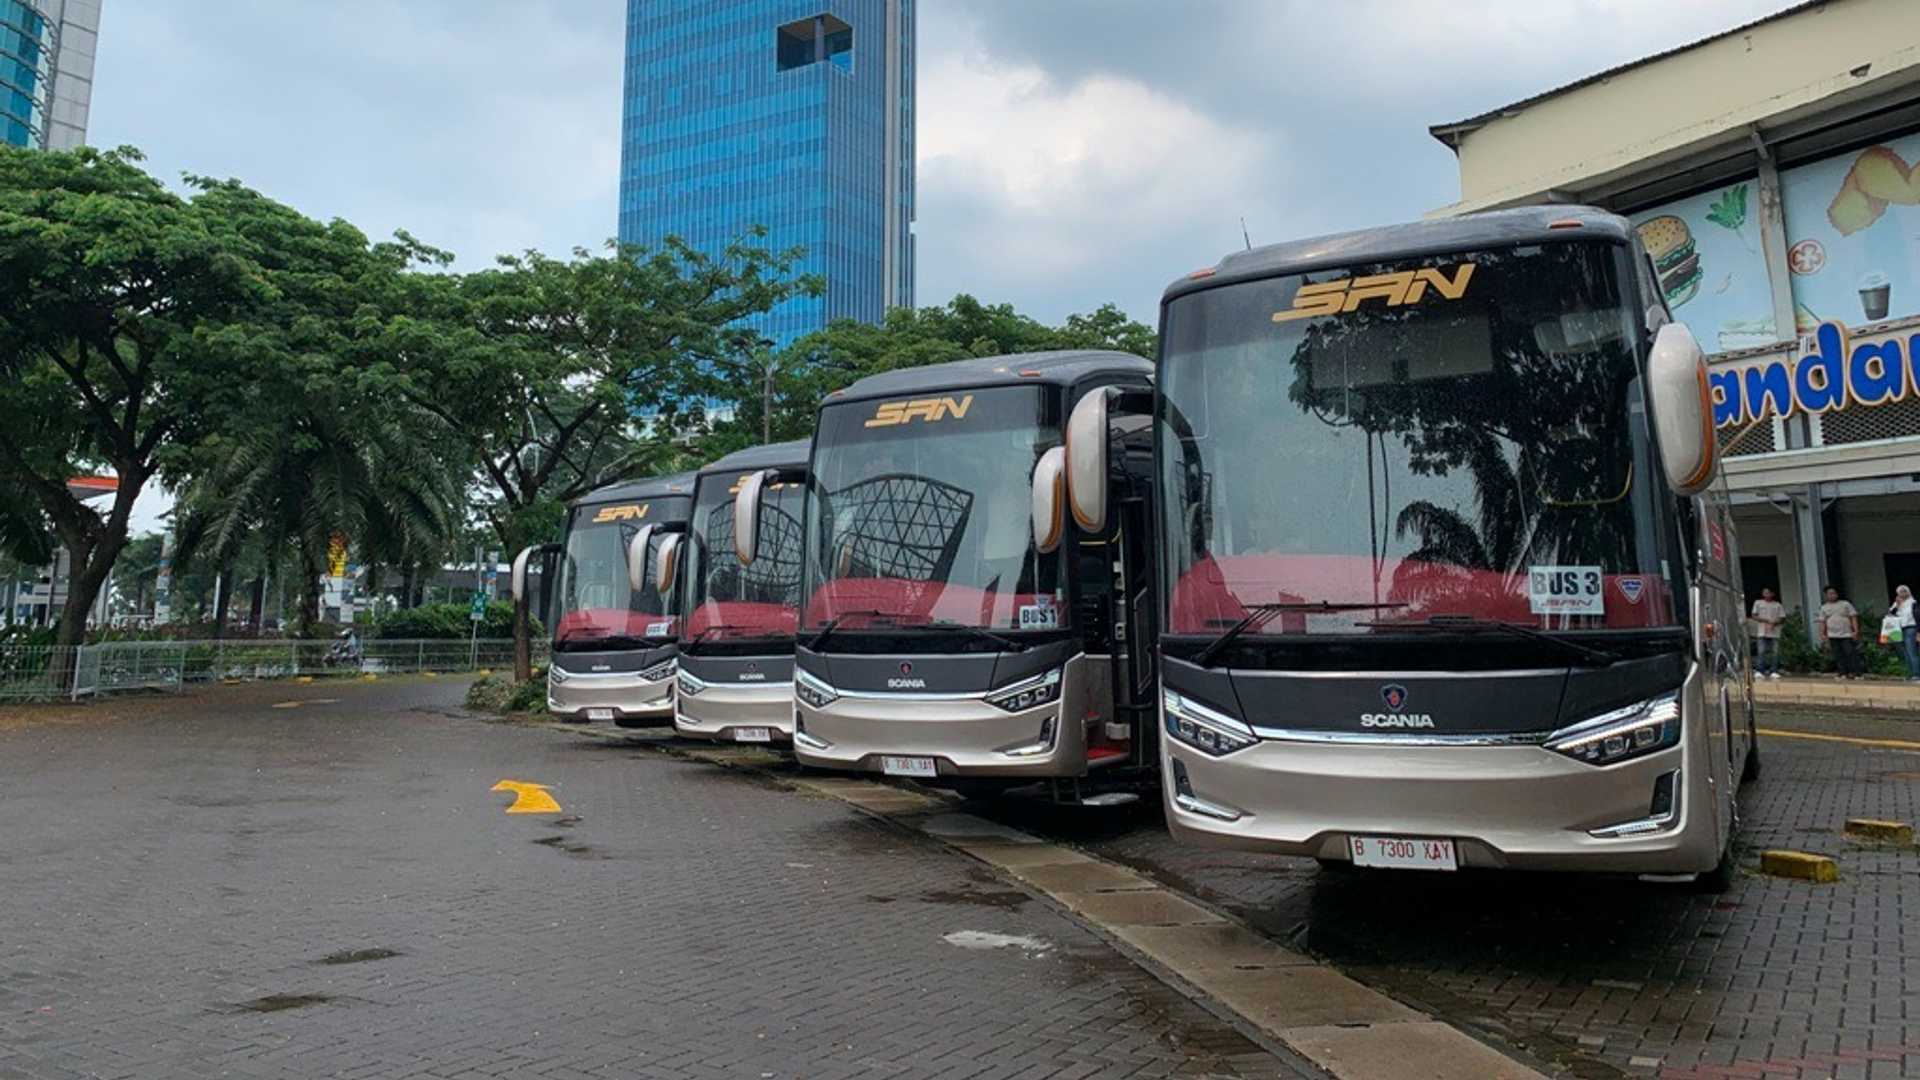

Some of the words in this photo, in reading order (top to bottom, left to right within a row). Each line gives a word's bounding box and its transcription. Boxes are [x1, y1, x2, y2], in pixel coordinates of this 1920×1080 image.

[1272, 263, 1476, 322] SAN
[1709, 321, 1920, 428] anda
[864, 394, 974, 428] SAN
[592, 503, 649, 523] SAN
[1531, 571, 1579, 596] BUS
[1583, 571, 1600, 595] 3
[1022, 608, 1048, 624] BUS
[887, 678, 926, 688] SCANIA
[1360, 713, 1435, 728] SCANIA
[1354, 839, 1365, 856] B
[1377, 840, 1415, 858] 7300
[1422, 841, 1449, 860] XAY
